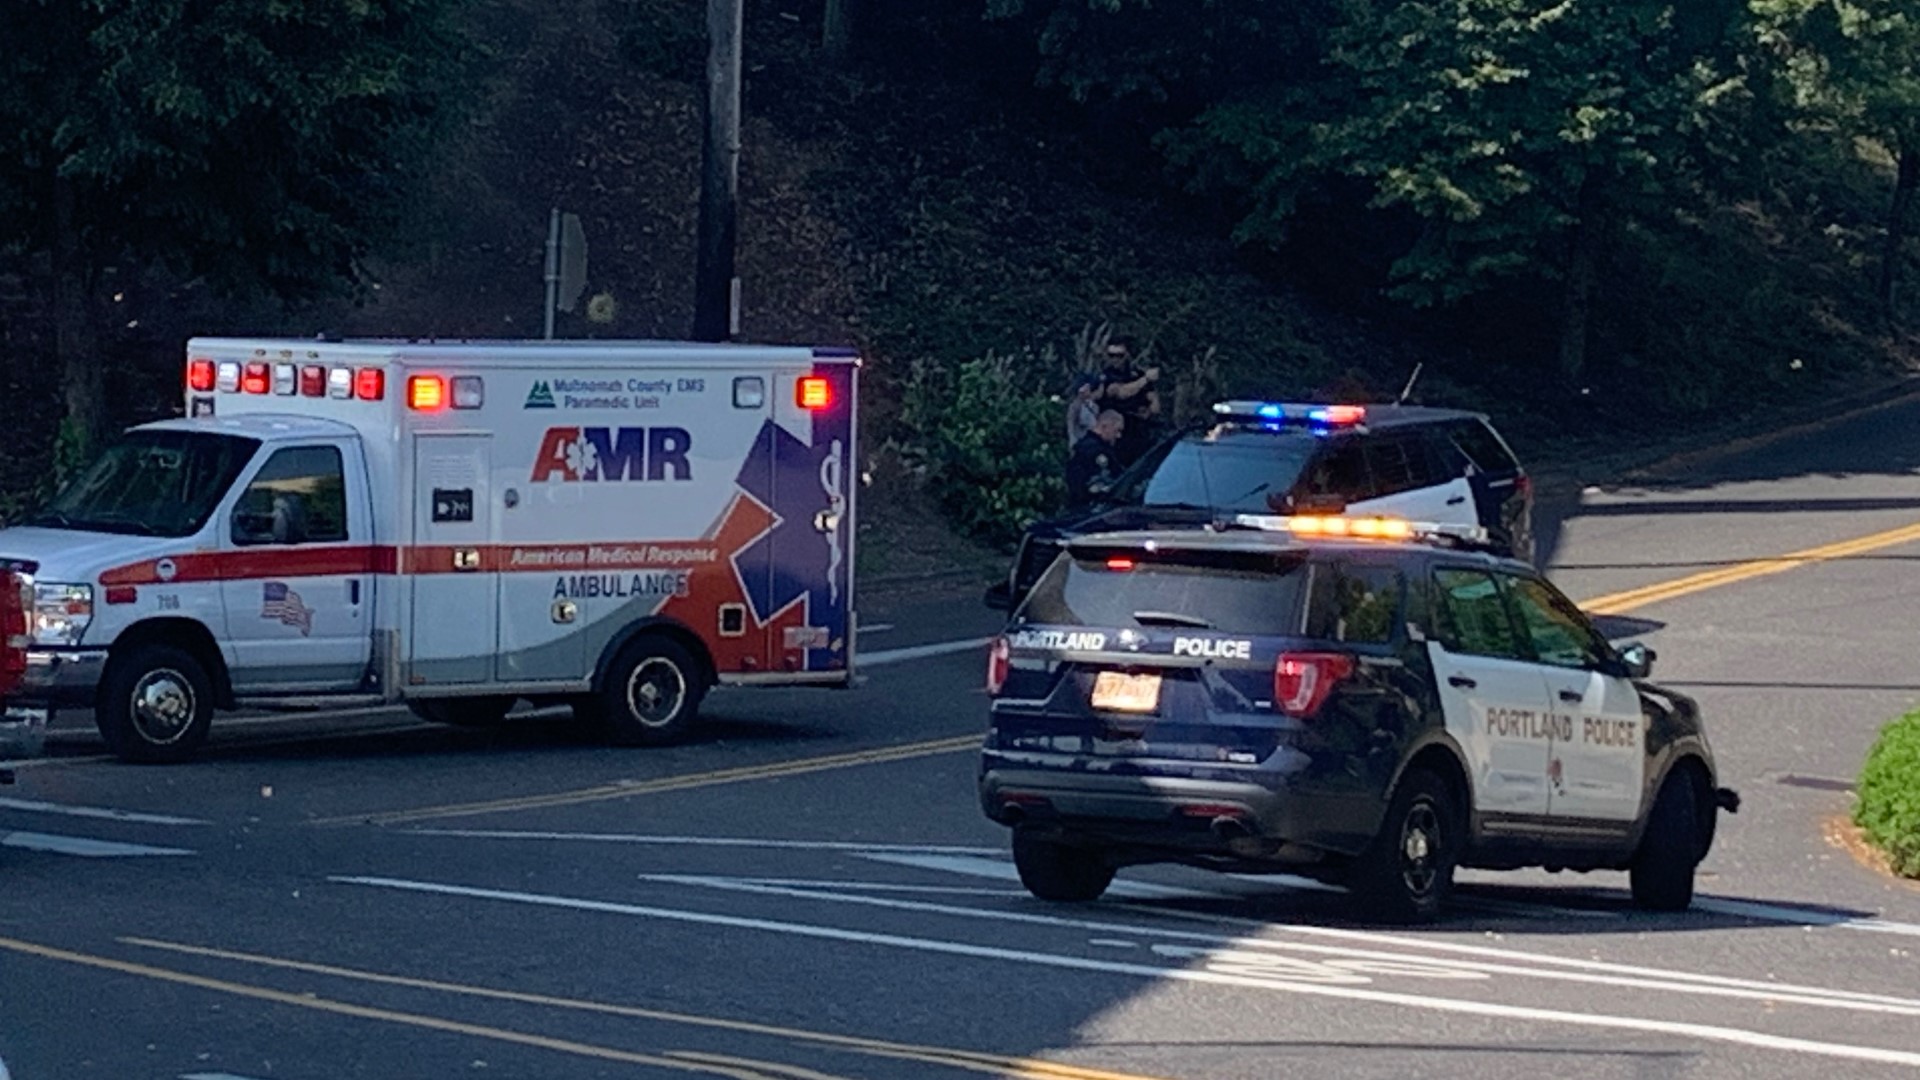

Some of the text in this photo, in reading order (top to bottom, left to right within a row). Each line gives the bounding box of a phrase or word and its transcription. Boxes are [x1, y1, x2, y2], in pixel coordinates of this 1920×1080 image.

[627, 378, 672, 394] County
[677, 379, 705, 392] EMS
[564, 395, 660, 409] Paramedic Unit
[530, 426, 692, 482] AMR
[511, 546, 718, 564] American Medical Response
[553, 573, 689, 599] AMBULANCE
[1014, 630, 1252, 659] PORTLAND POLICE
[1487, 707, 1637, 746] PORTLAND POLICE
